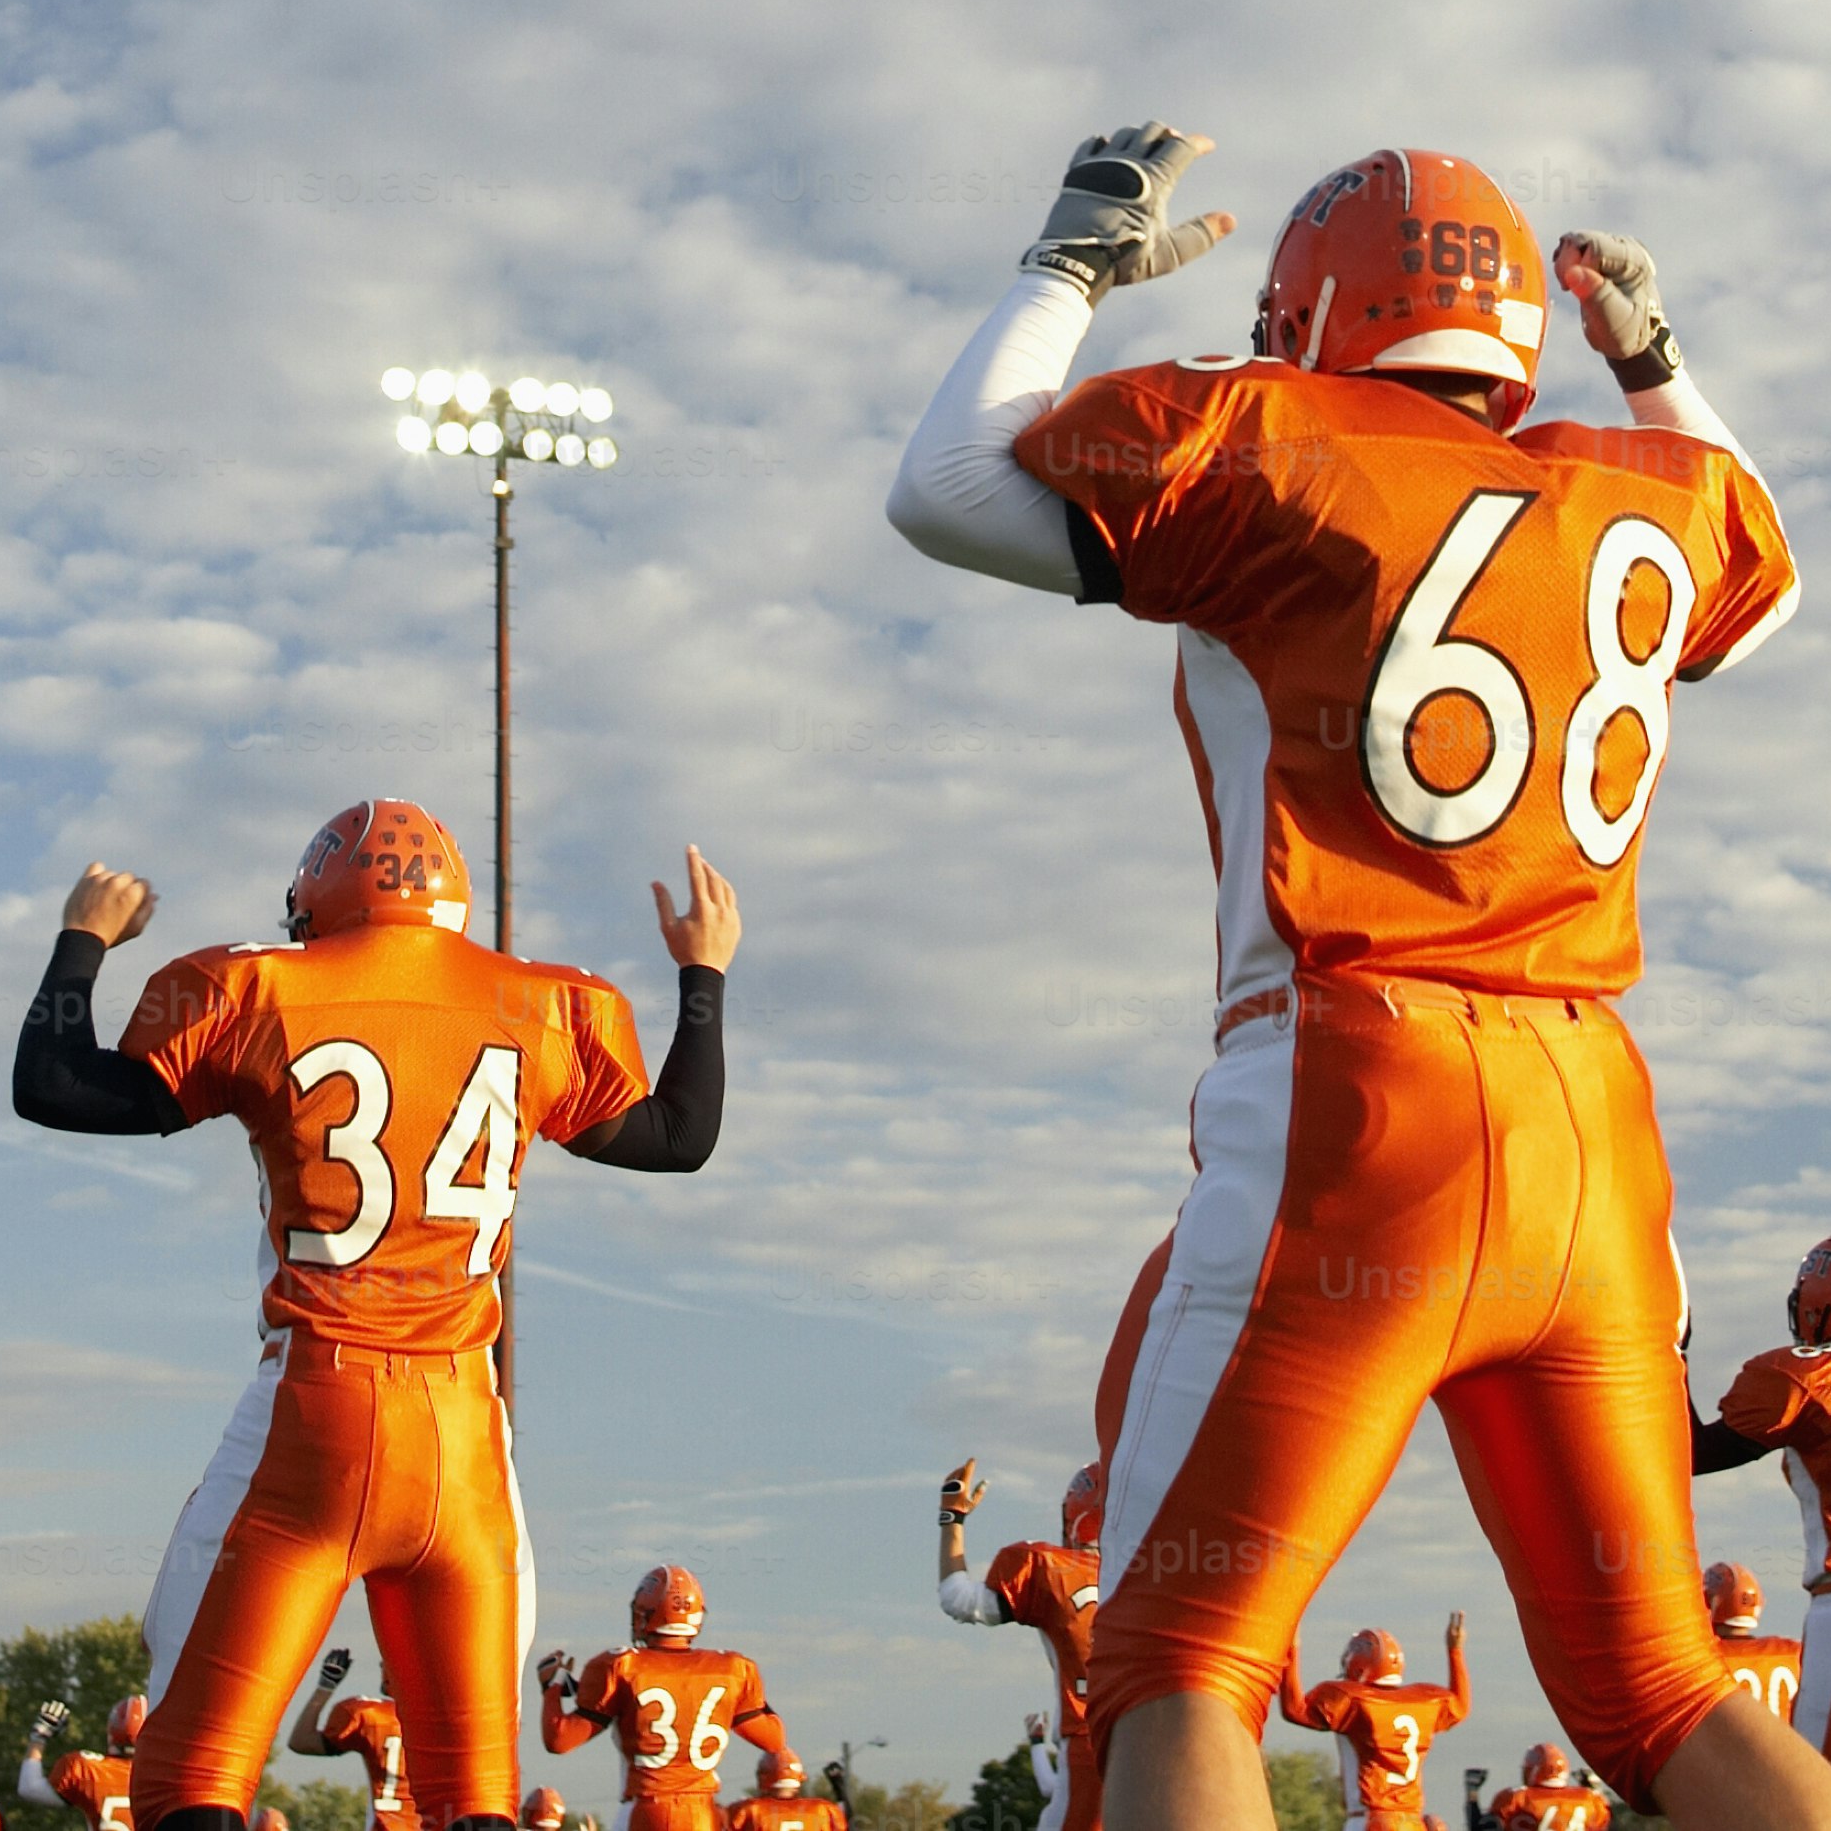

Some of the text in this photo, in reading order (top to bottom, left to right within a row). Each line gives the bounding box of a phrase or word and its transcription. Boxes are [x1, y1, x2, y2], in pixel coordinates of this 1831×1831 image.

[1430, 221, 1501, 281] 68
[1359, 486, 1699, 868] 68
[376, 854, 426, 891] 34
[285, 1038, 523, 1278] 34
[634, 1686, 730, 1772] 36
[1386, 1714, 1421, 1786] 3
